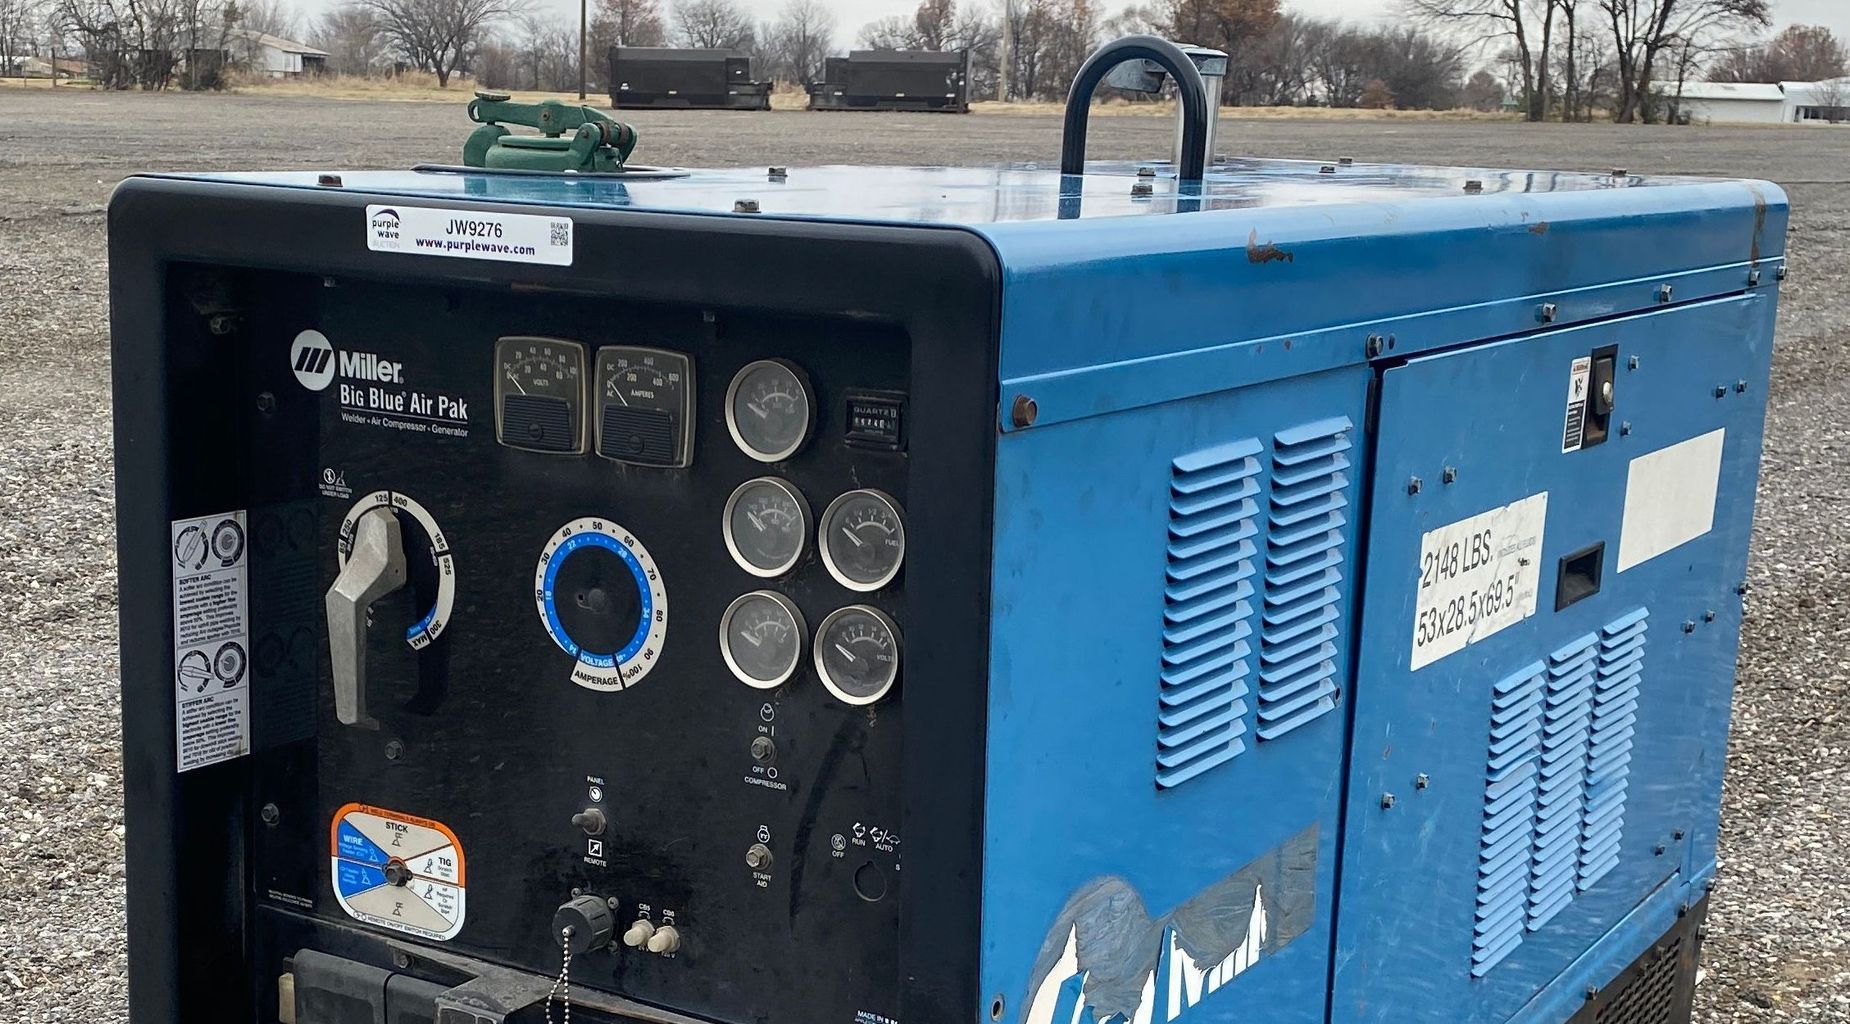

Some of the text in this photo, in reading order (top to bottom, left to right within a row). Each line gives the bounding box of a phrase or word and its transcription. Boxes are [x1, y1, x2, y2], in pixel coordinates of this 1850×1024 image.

[372, 216, 400, 232] purple
[446, 218, 502, 238] JW9276
[378, 229, 400, 239] wave
[416, 236, 535, 256] www.purplewave.com
[339, 350, 402, 384] Miller
[370, 388, 404, 412] Blue
[410, 392, 433, 416] Air
[438, 396, 468, 420] Pak
[341, 412, 468, 438] Welder Air Compressor Generator
[374, 494, 388, 503] 125
[394, 496, 408, 508] 400
[342, 518, 352, 536] 250
[592, 521, 602, 531] 50
[562, 527, 572, 538] 40
[434, 532, 446, 550] 185
[567, 539, 576, 550] 22
[624, 535, 635, 548] 60
[540, 552, 550, 566] 30
[1422, 542, 1459, 590] 2148
[1462, 528, 1494, 572] LBS.
[443, 557, 452, 576] 525
[647, 568, 657, 581] 70
[536, 589, 544, 602] 20
[642, 607, 650, 618] 34
[656, 609, 664, 622] 80
[430, 618, 442, 635] 300
[411, 634, 428, 647] MAX
[580, 652, 614, 668] VOLTAGE
[644, 648, 654, 660] 90
[574, 669, 618, 686] AMPERAGE
[622, 663, 643, 682] 100%
[758, 725, 768, 733] ON
[752, 766, 764, 774] OFF
[586, 775, 605, 786] PANEL
[744, 776, 786, 790] COMPRESSOR
[386, 822, 408, 833] STICK
[344, 834, 363, 846] WIRE
[852, 838, 866, 847] RUN
[832, 850, 845, 858] OFF
[876, 844, 894, 852] AUTO
[438, 856, 452, 867] TIG
[584, 856, 607, 868] REMOTE
[752, 872, 772, 882] START
[756, 880, 768, 888] AID
[858, 1010, 876, 1021] MADE
